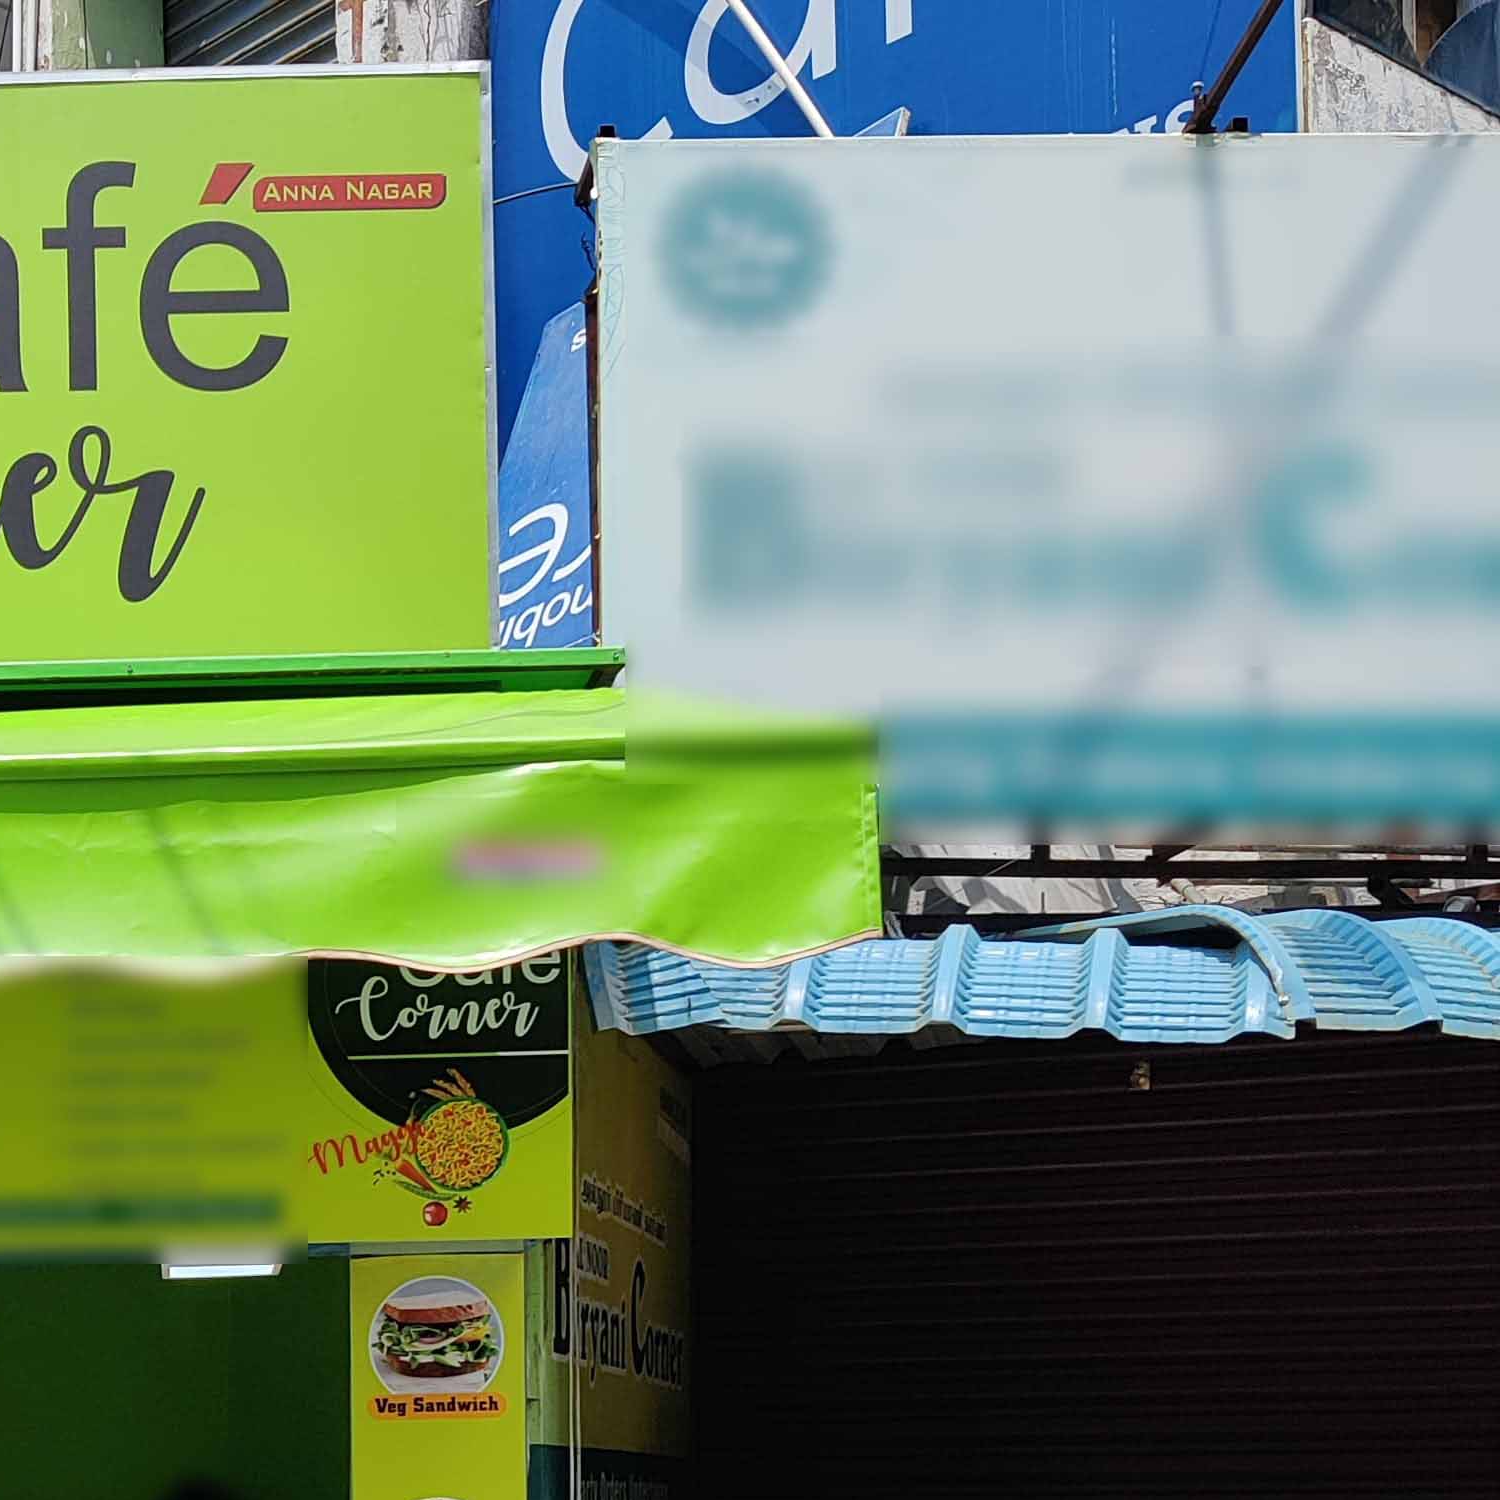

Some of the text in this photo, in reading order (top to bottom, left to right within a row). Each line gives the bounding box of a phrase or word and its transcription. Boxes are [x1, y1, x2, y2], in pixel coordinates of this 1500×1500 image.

[335, 975, 539, 1041] Corner
[374, 1395, 499, 1417] Veg Sandwich
